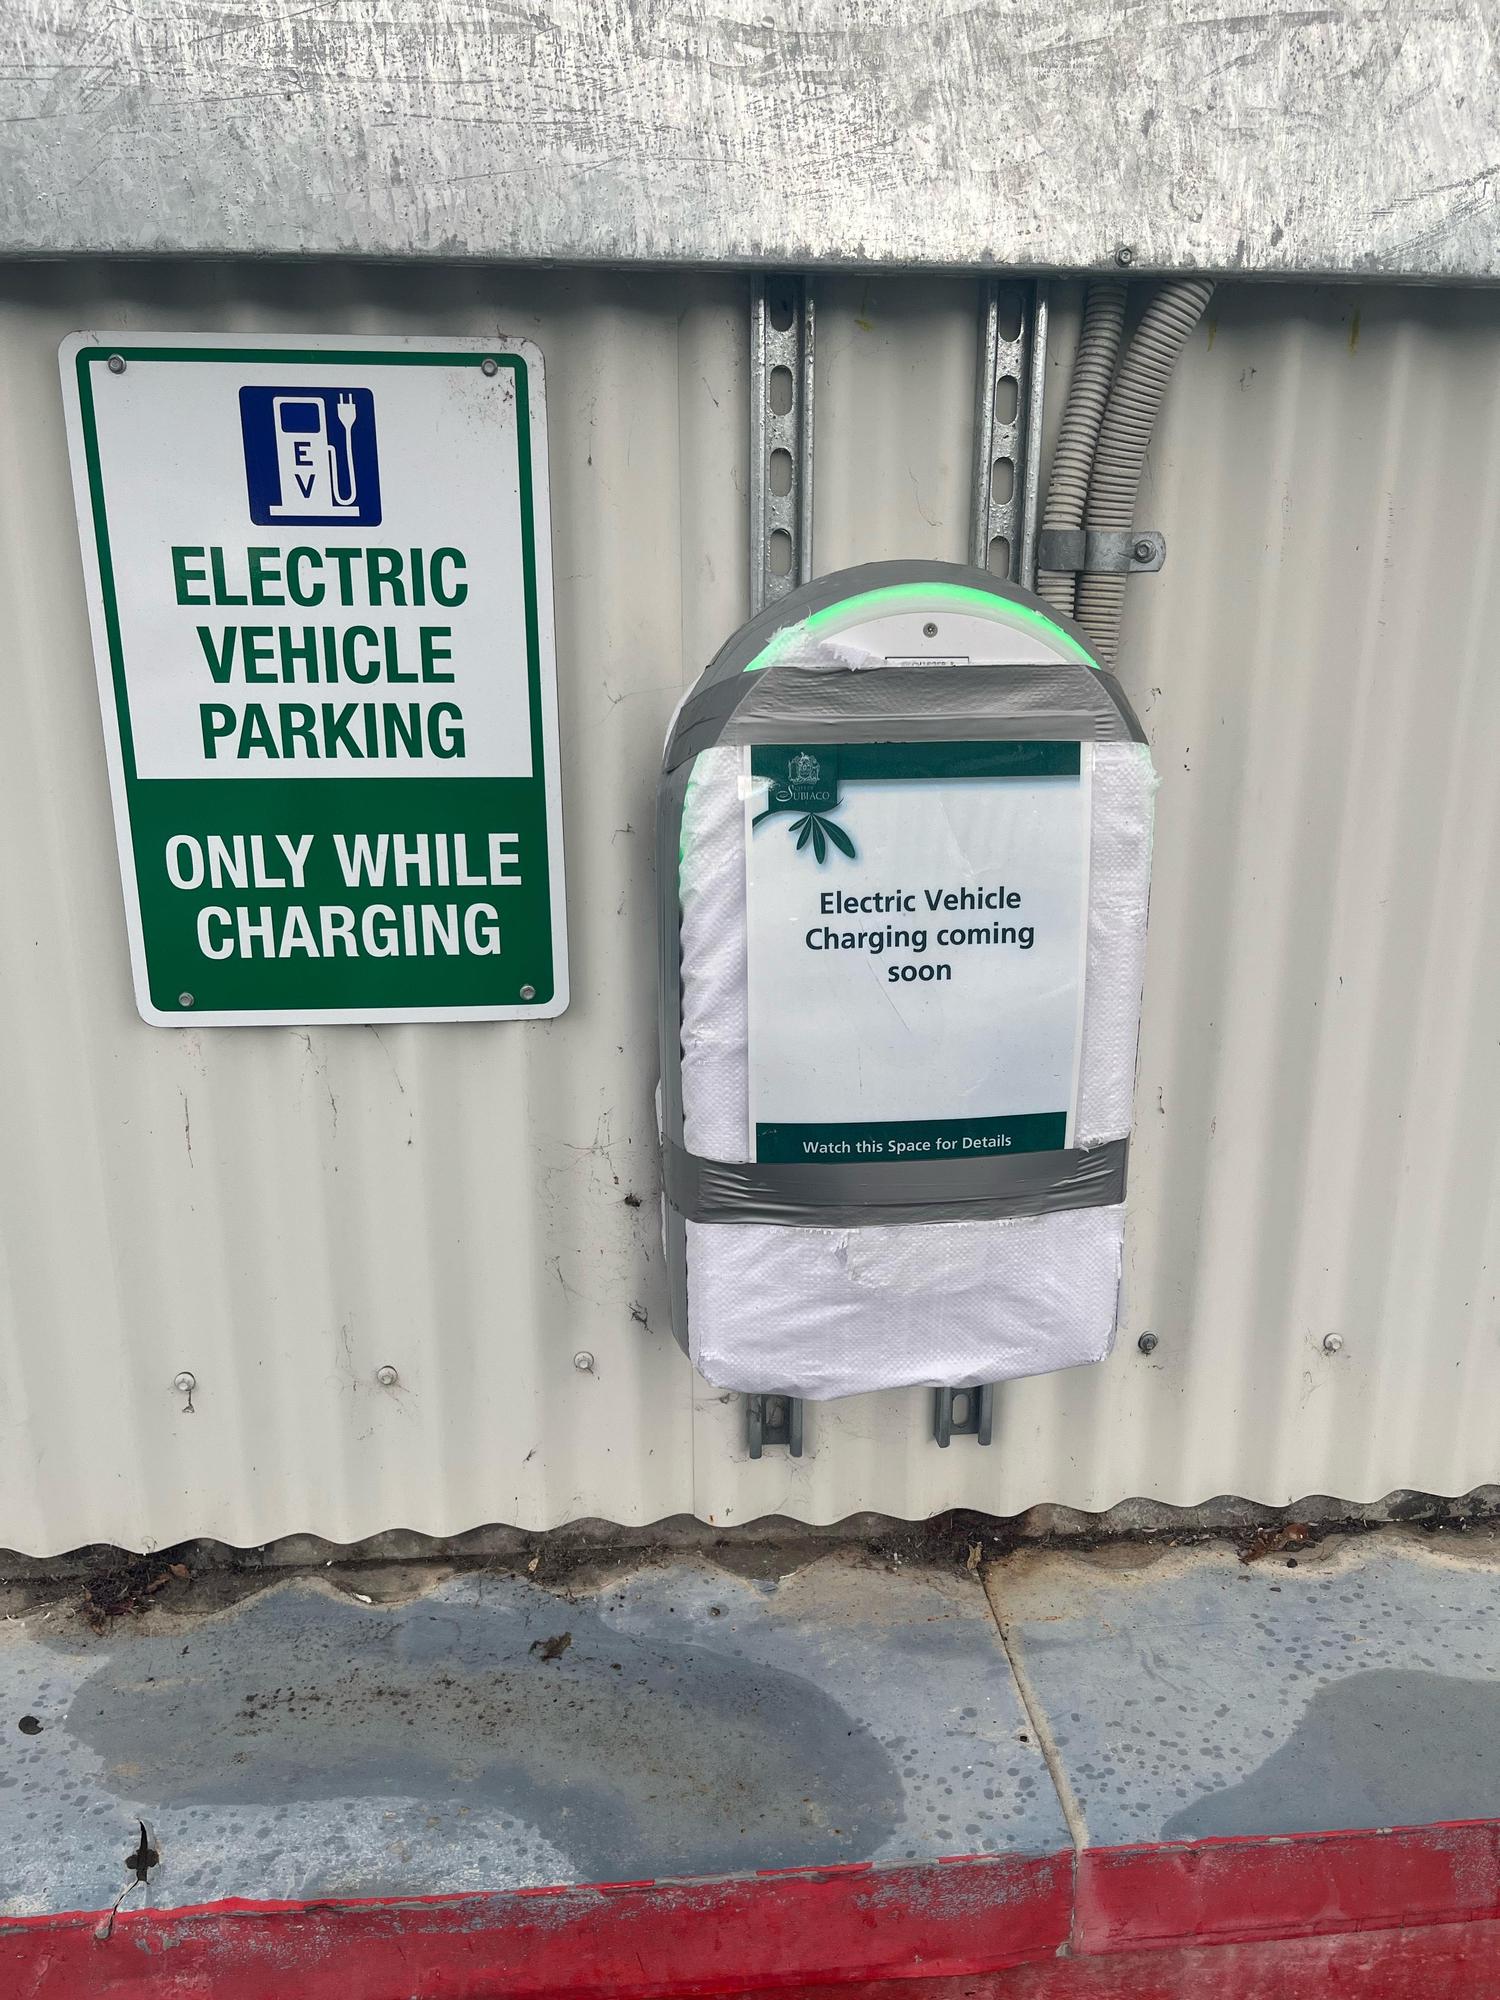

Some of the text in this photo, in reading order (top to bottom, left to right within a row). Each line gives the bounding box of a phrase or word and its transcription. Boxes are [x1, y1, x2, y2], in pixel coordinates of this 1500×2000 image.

[171, 546, 468, 608] ELECTRIC
[197, 626, 455, 684] VEHICLE
[200, 702, 466, 759] PARKING
[165, 833, 523, 889] ONLY WHILE
[820, 886, 1021, 914] Electric Vehicle
[196, 904, 501, 959] CHARGING
[806, 922, 1034, 954] Charging coming
[888, 964, 951, 982] soon
[803, 1134, 1011, 1154] Watch this Space for Details
